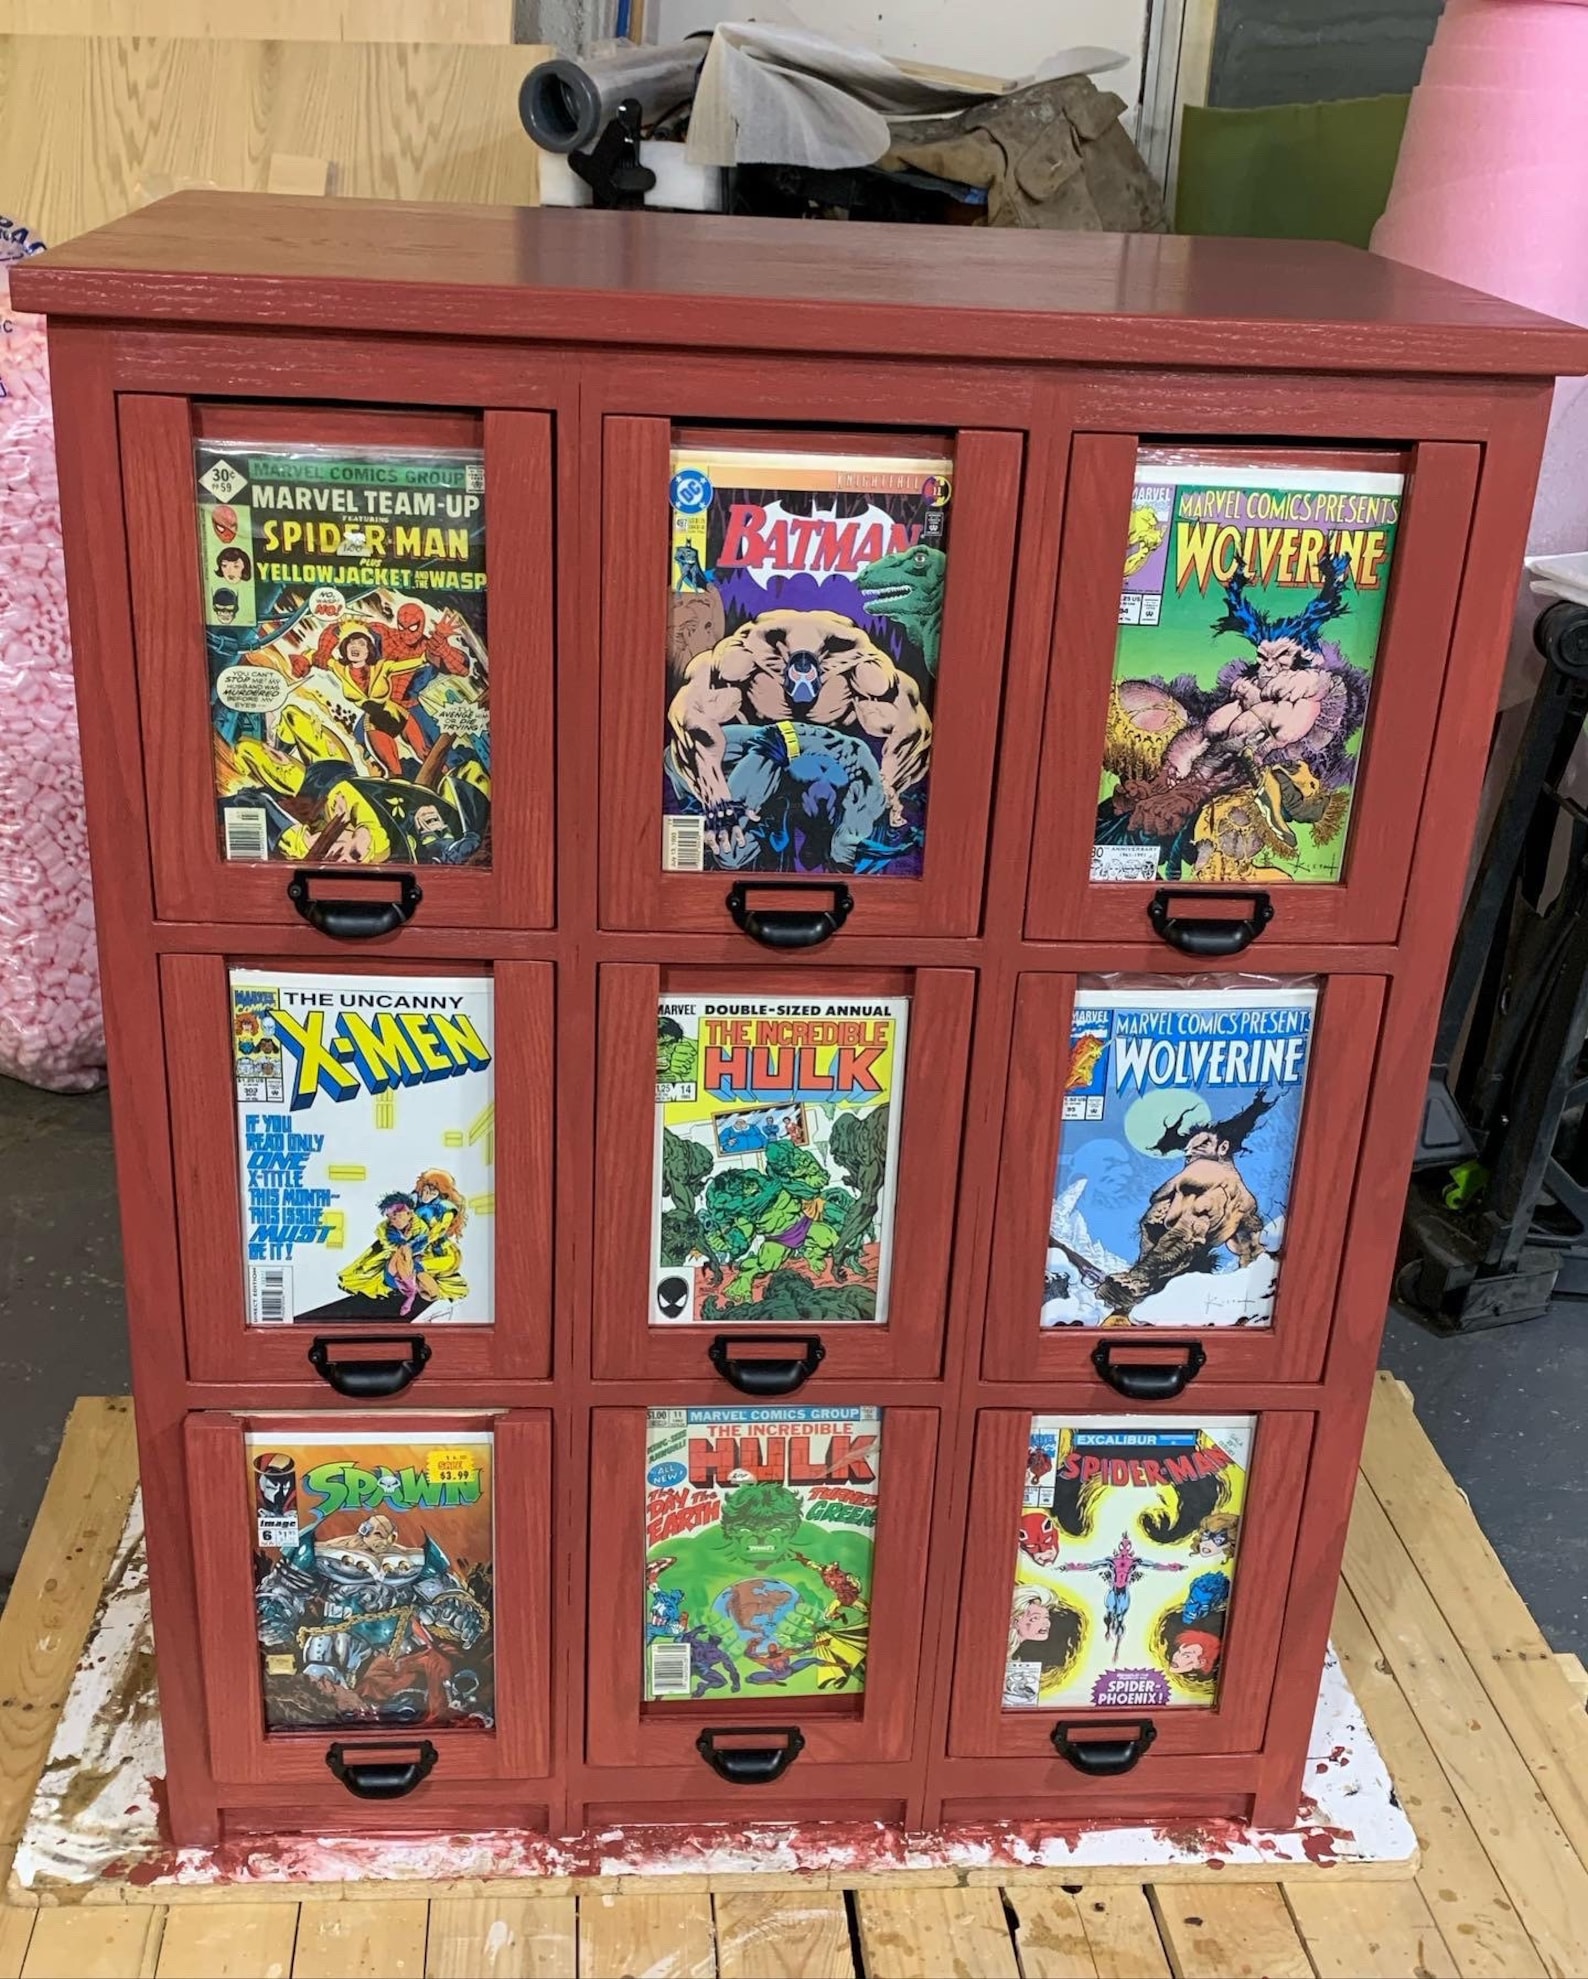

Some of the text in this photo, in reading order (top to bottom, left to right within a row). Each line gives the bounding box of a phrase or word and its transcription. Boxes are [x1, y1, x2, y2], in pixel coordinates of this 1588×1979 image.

[253, 463, 323, 480] MARVEL
[330, 467, 398, 483] COMICS
[405, 469, 465, 486] GROUP
[252, 485, 480, 518] MARVEL TEAM-UP
[680, 481, 700, 503] DC
[1179, 490, 1399, 525] MARVEL COMICS PRESENTS
[717, 504, 922, 571] BATMAN
[359, 557, 382, 567] PLUS
[256, 562, 411, 588] YELLOWJACKET
[429, 571, 487, 590] WASP
[315, 604, 343, 616] NO!
[284, 991, 464, 1010] THE UNCANNY
[657, 1004, 697, 1015] MARVEL
[705, 1004, 891, 1017] DOUBLE-SIZED ANNUAL
[705, 1020, 890, 1047] THE INCREDIBLE
[1117, 1012, 1173, 1036] MARVEL
[1178, 1012, 1239, 1036] COMICS
[268, 1009, 492, 1112] X-MEN
[1115, 1037, 1305, 1094] WOLVERINE
[704, 1046, 887, 1100] HULK
[681, 1085, 691, 1095] 14
[246, 1114, 292, 1133] IF YOU
[246, 1133, 325, 1152] READ ONLY
[247, 1151, 311, 1170] ONE
[248, 1169, 303, 1188] X-TITLE
[248, 1188, 279, 1206] THIS
[248, 1207, 323, 1225] THIS ISSUE
[249, 1225, 336, 1244] MUST
[248, 1243, 266, 1260] BE
[690, 1409, 744, 1422] MARVEL
[751, 1408, 805, 1421] COMICS
[811, 1407, 860, 1420] GROUP
[707, 1422, 854, 1437] THE INCREDIBLE
[1077, 1434, 1157, 1446] EXCALIBUR
[657, 1465, 675, 1476] ALL
[688, 1435, 878, 1488] HULK
[1059, 1444, 1235, 1487] SPIDER-MAN
[440, 1470, 469, 1480] $3.99
[653, 1472, 678, 1484] NEW
[302, 1461, 484, 1519] SPAWN
[647, 1487, 690, 1521] DAY
[647, 1499, 721, 1547] EARTH
[262, 1530, 272, 1541] 6
[1107, 1680, 1161, 1692] SPIDER-
